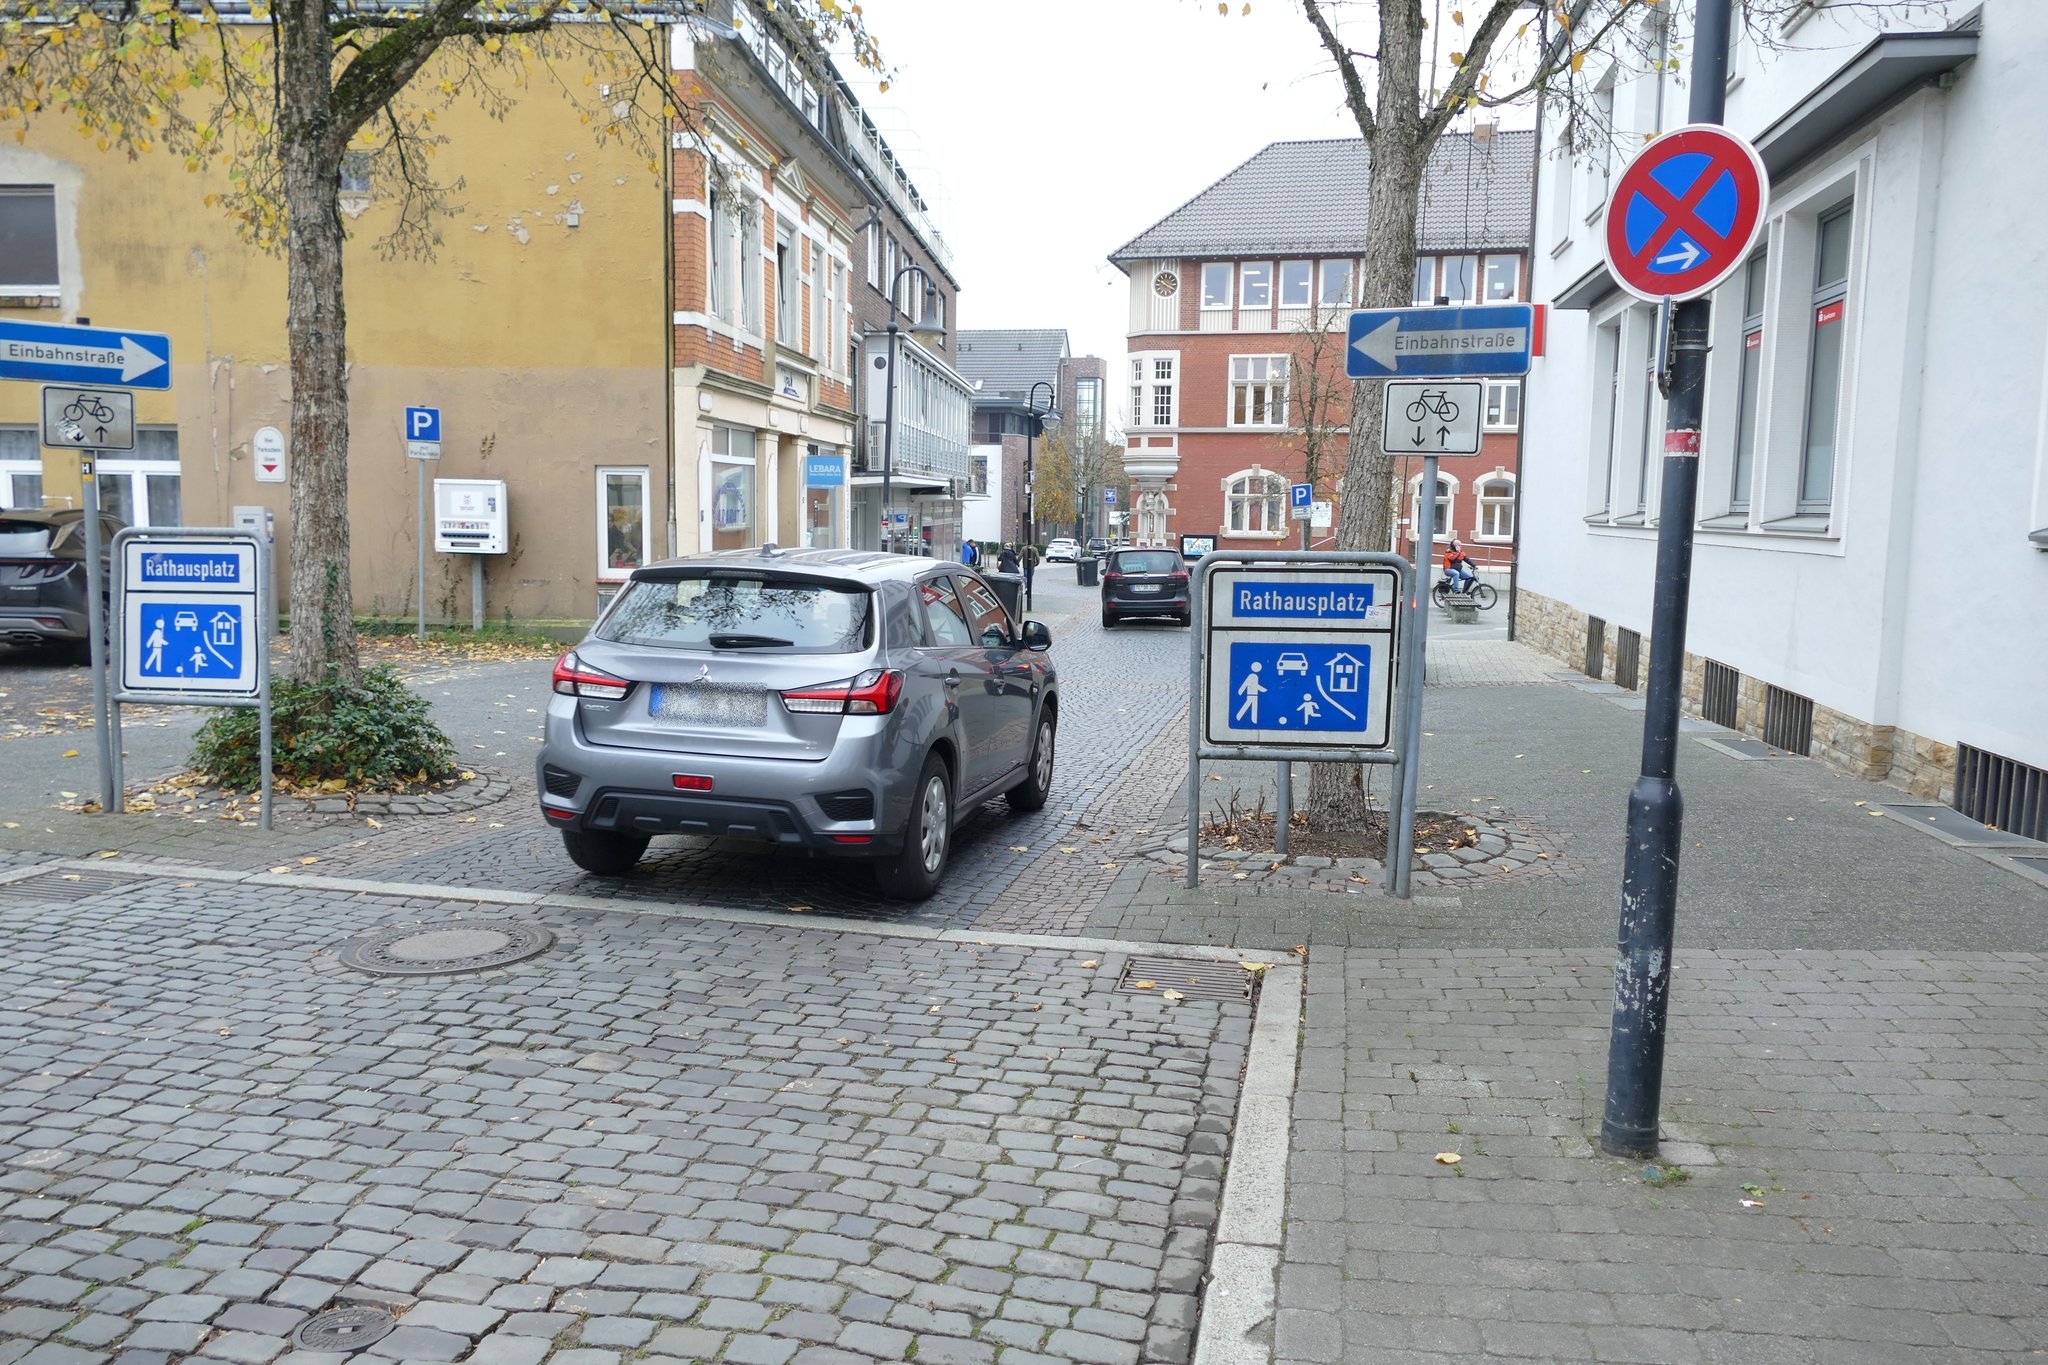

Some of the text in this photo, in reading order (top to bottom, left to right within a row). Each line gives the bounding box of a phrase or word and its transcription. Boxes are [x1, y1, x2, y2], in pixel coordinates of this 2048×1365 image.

[1394, 333, 1516, 351] Einbahnstraße
[9, 343, 125, 364] Einbahnstraße
[413, 411, 432, 437] P
[809, 464, 841, 473] LEBARA
[1295, 487, 1307, 504] P
[146, 559, 235, 581] Rathausplatz
[1240, 589, 1366, 617] Rathausplatz
